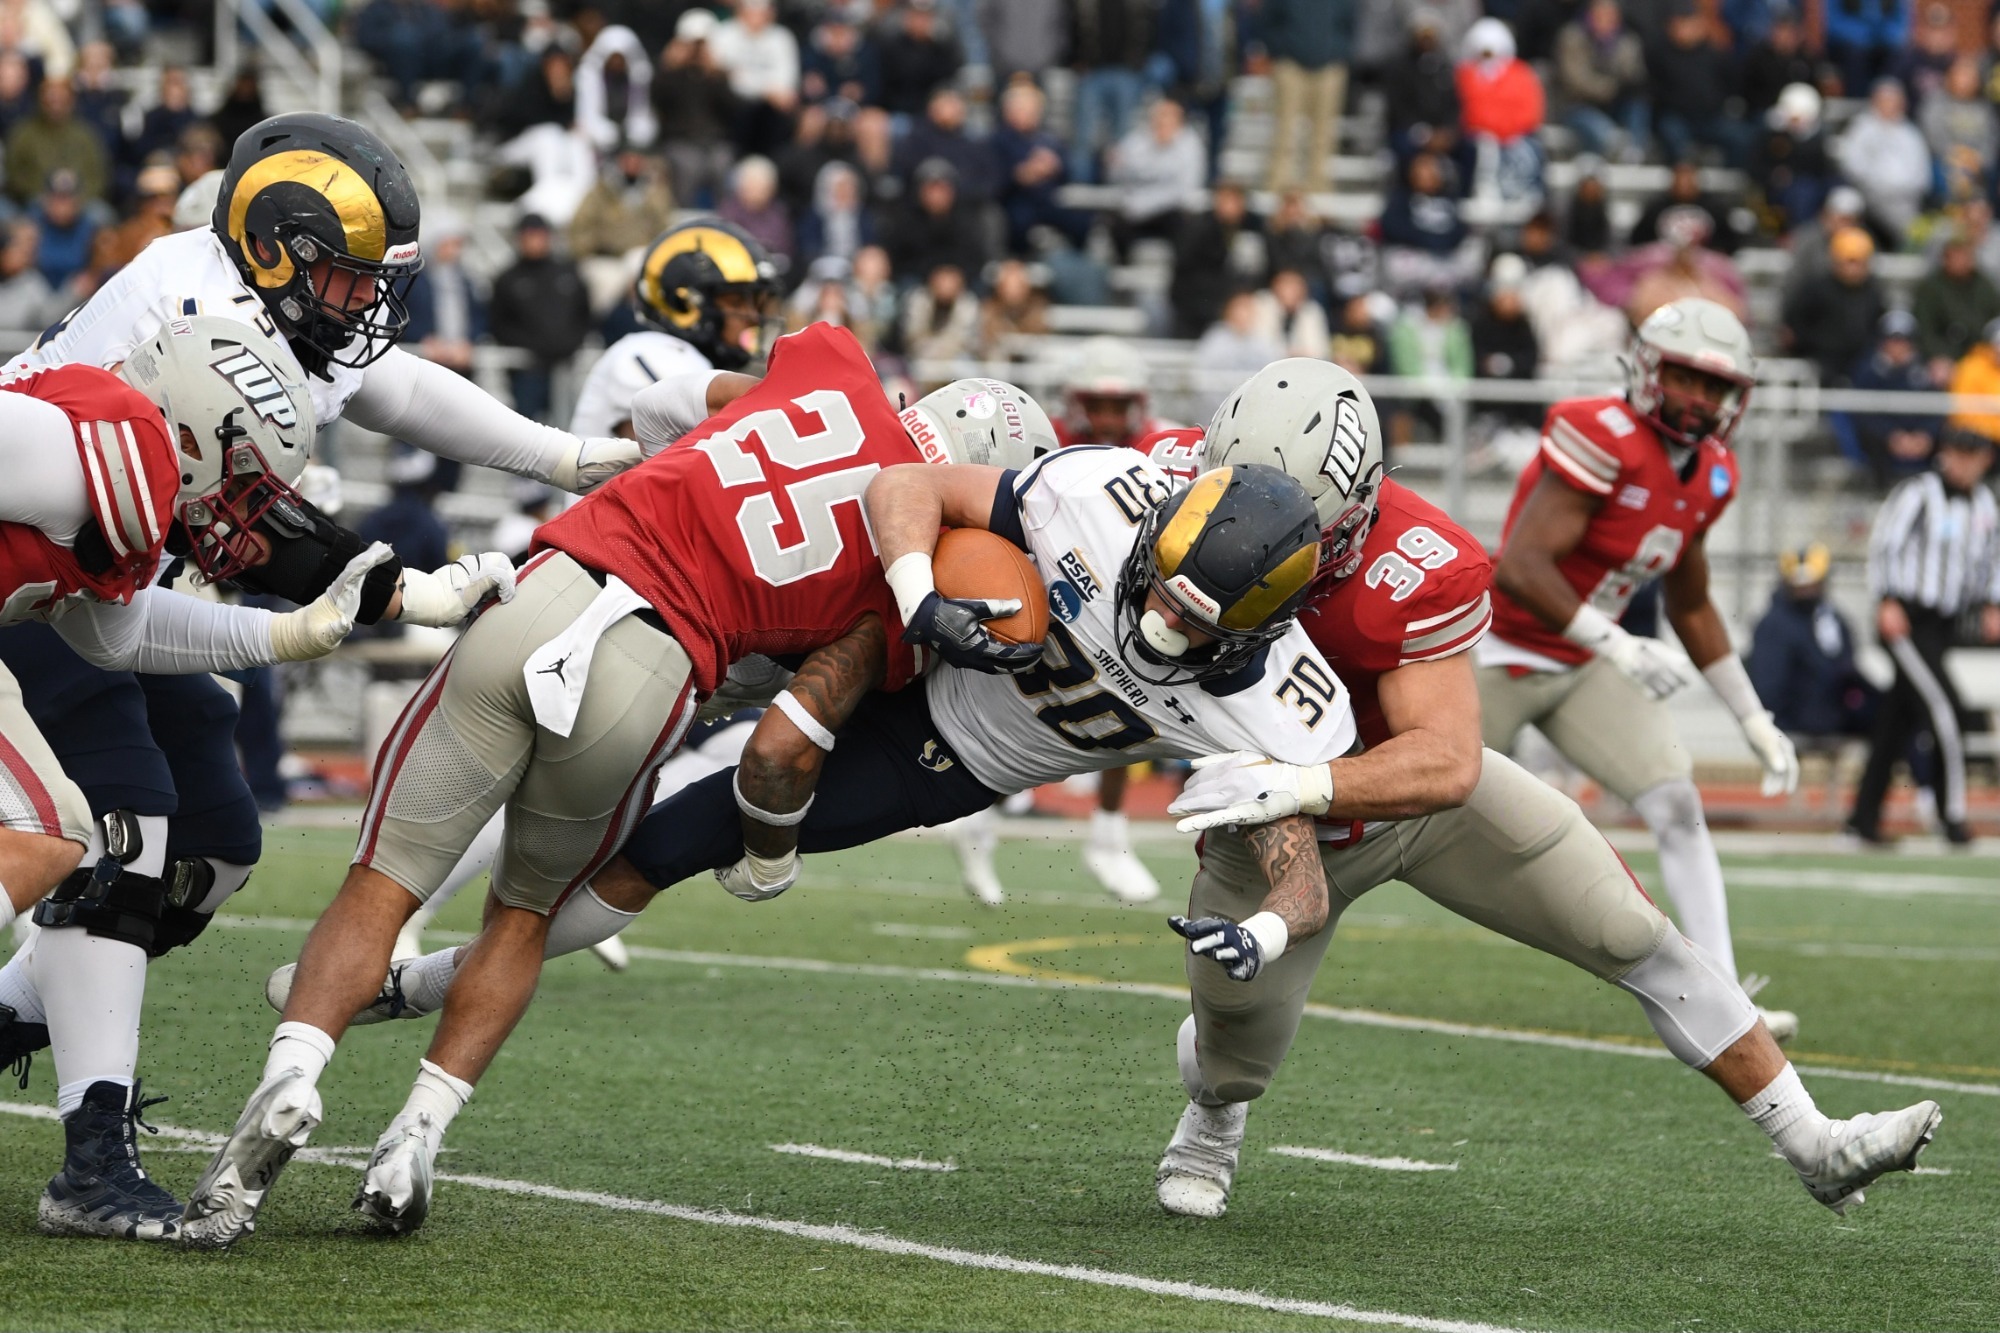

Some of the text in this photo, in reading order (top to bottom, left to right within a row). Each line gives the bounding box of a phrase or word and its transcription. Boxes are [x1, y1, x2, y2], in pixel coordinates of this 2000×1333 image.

[209, 346, 297, 430] IUP
[901, 409, 950, 464] Riddel
[1001, 402, 1024, 442] GUY
[1319, 398, 1367, 499] IUP
[692, 390, 882, 587] 25
[1060, 550, 1101, 601] PSAC
[1365, 526, 1458, 601] 39
[1052, 588, 1073, 624] NCAA
[1177, 581, 1215, 615] Riddell
[1093, 648, 1149, 708] SHEPHERD
[1272, 652, 1337, 733] 30
